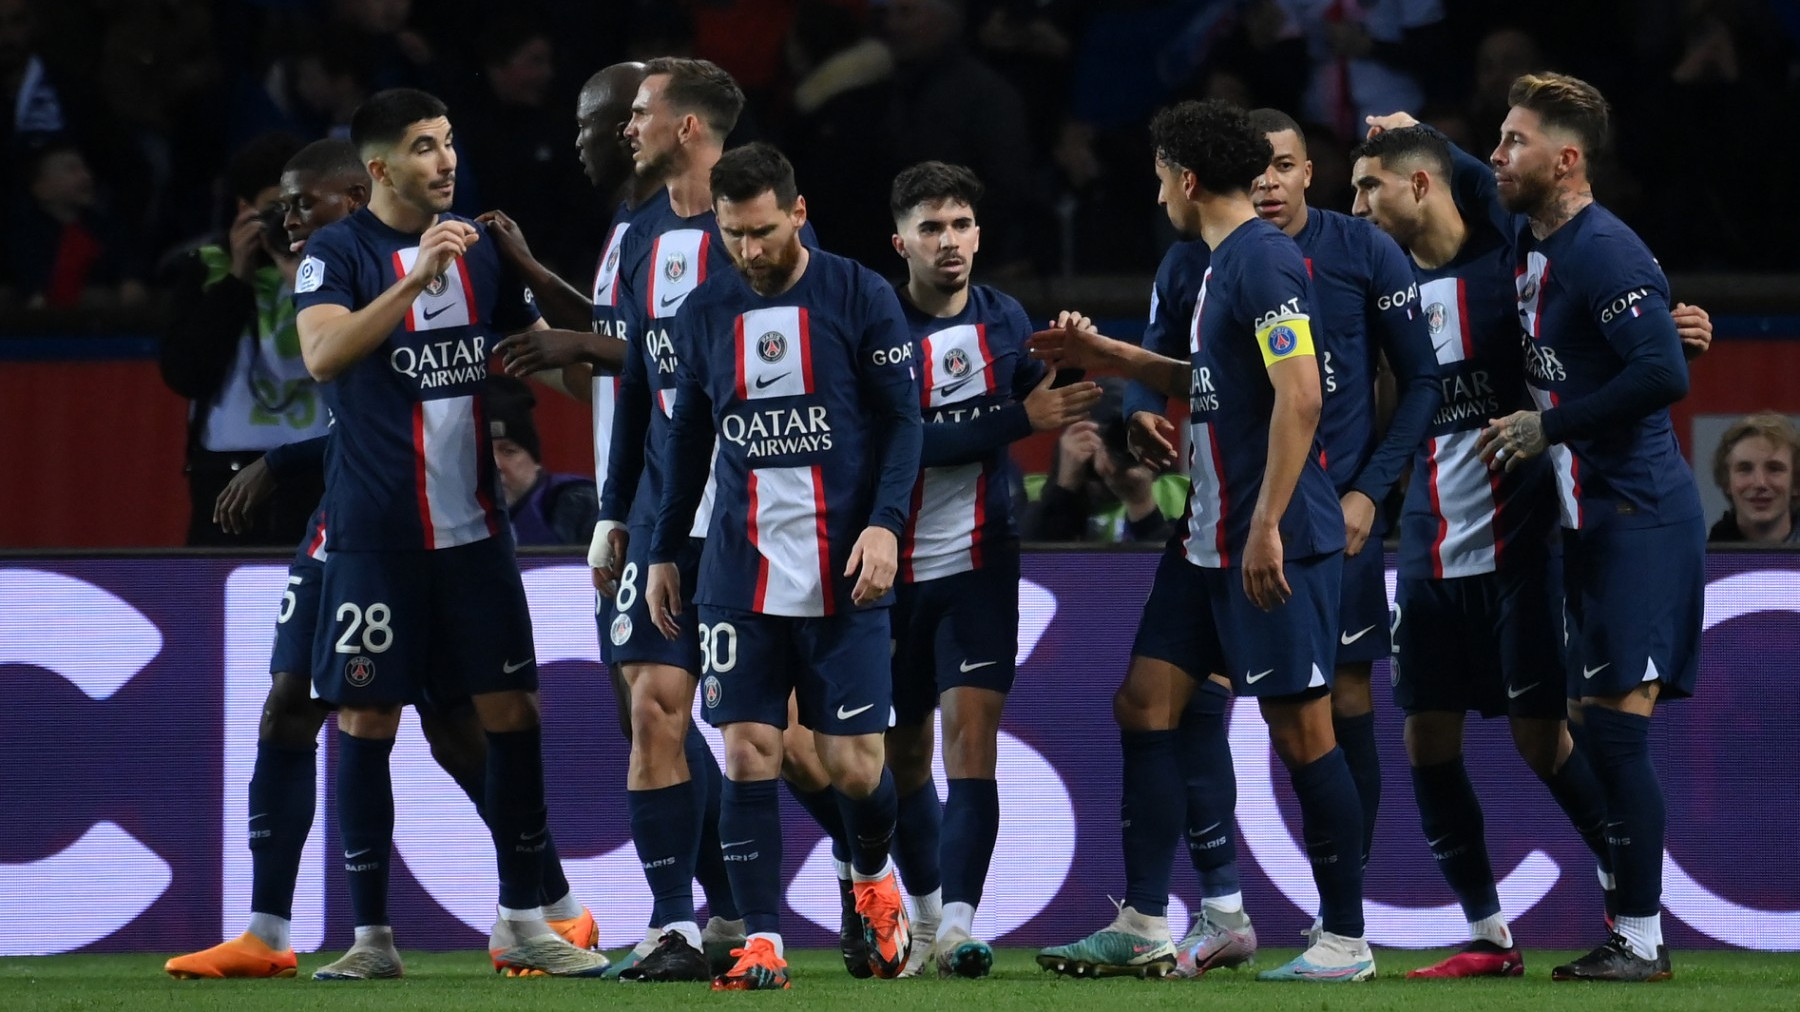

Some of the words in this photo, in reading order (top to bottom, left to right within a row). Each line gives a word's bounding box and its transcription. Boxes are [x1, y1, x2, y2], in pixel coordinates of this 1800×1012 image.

[592, 320, 628, 341] ATAR
[390, 336, 485, 378] QATAR
[420, 363, 487, 389] AIRWAYS
[1189, 366, 1216, 395] AR
[722, 406, 831, 447] QATAR
[746, 433, 833, 458] AIRWAYS
[616, 562, 638, 612] 8
[335, 602, 394, 654] 28
[698, 622, 737, 674] 30
[1606, 836, 1631, 846] RIS
[642, 856, 676, 869] ARIS
[723, 851, 759, 862] ARIS
